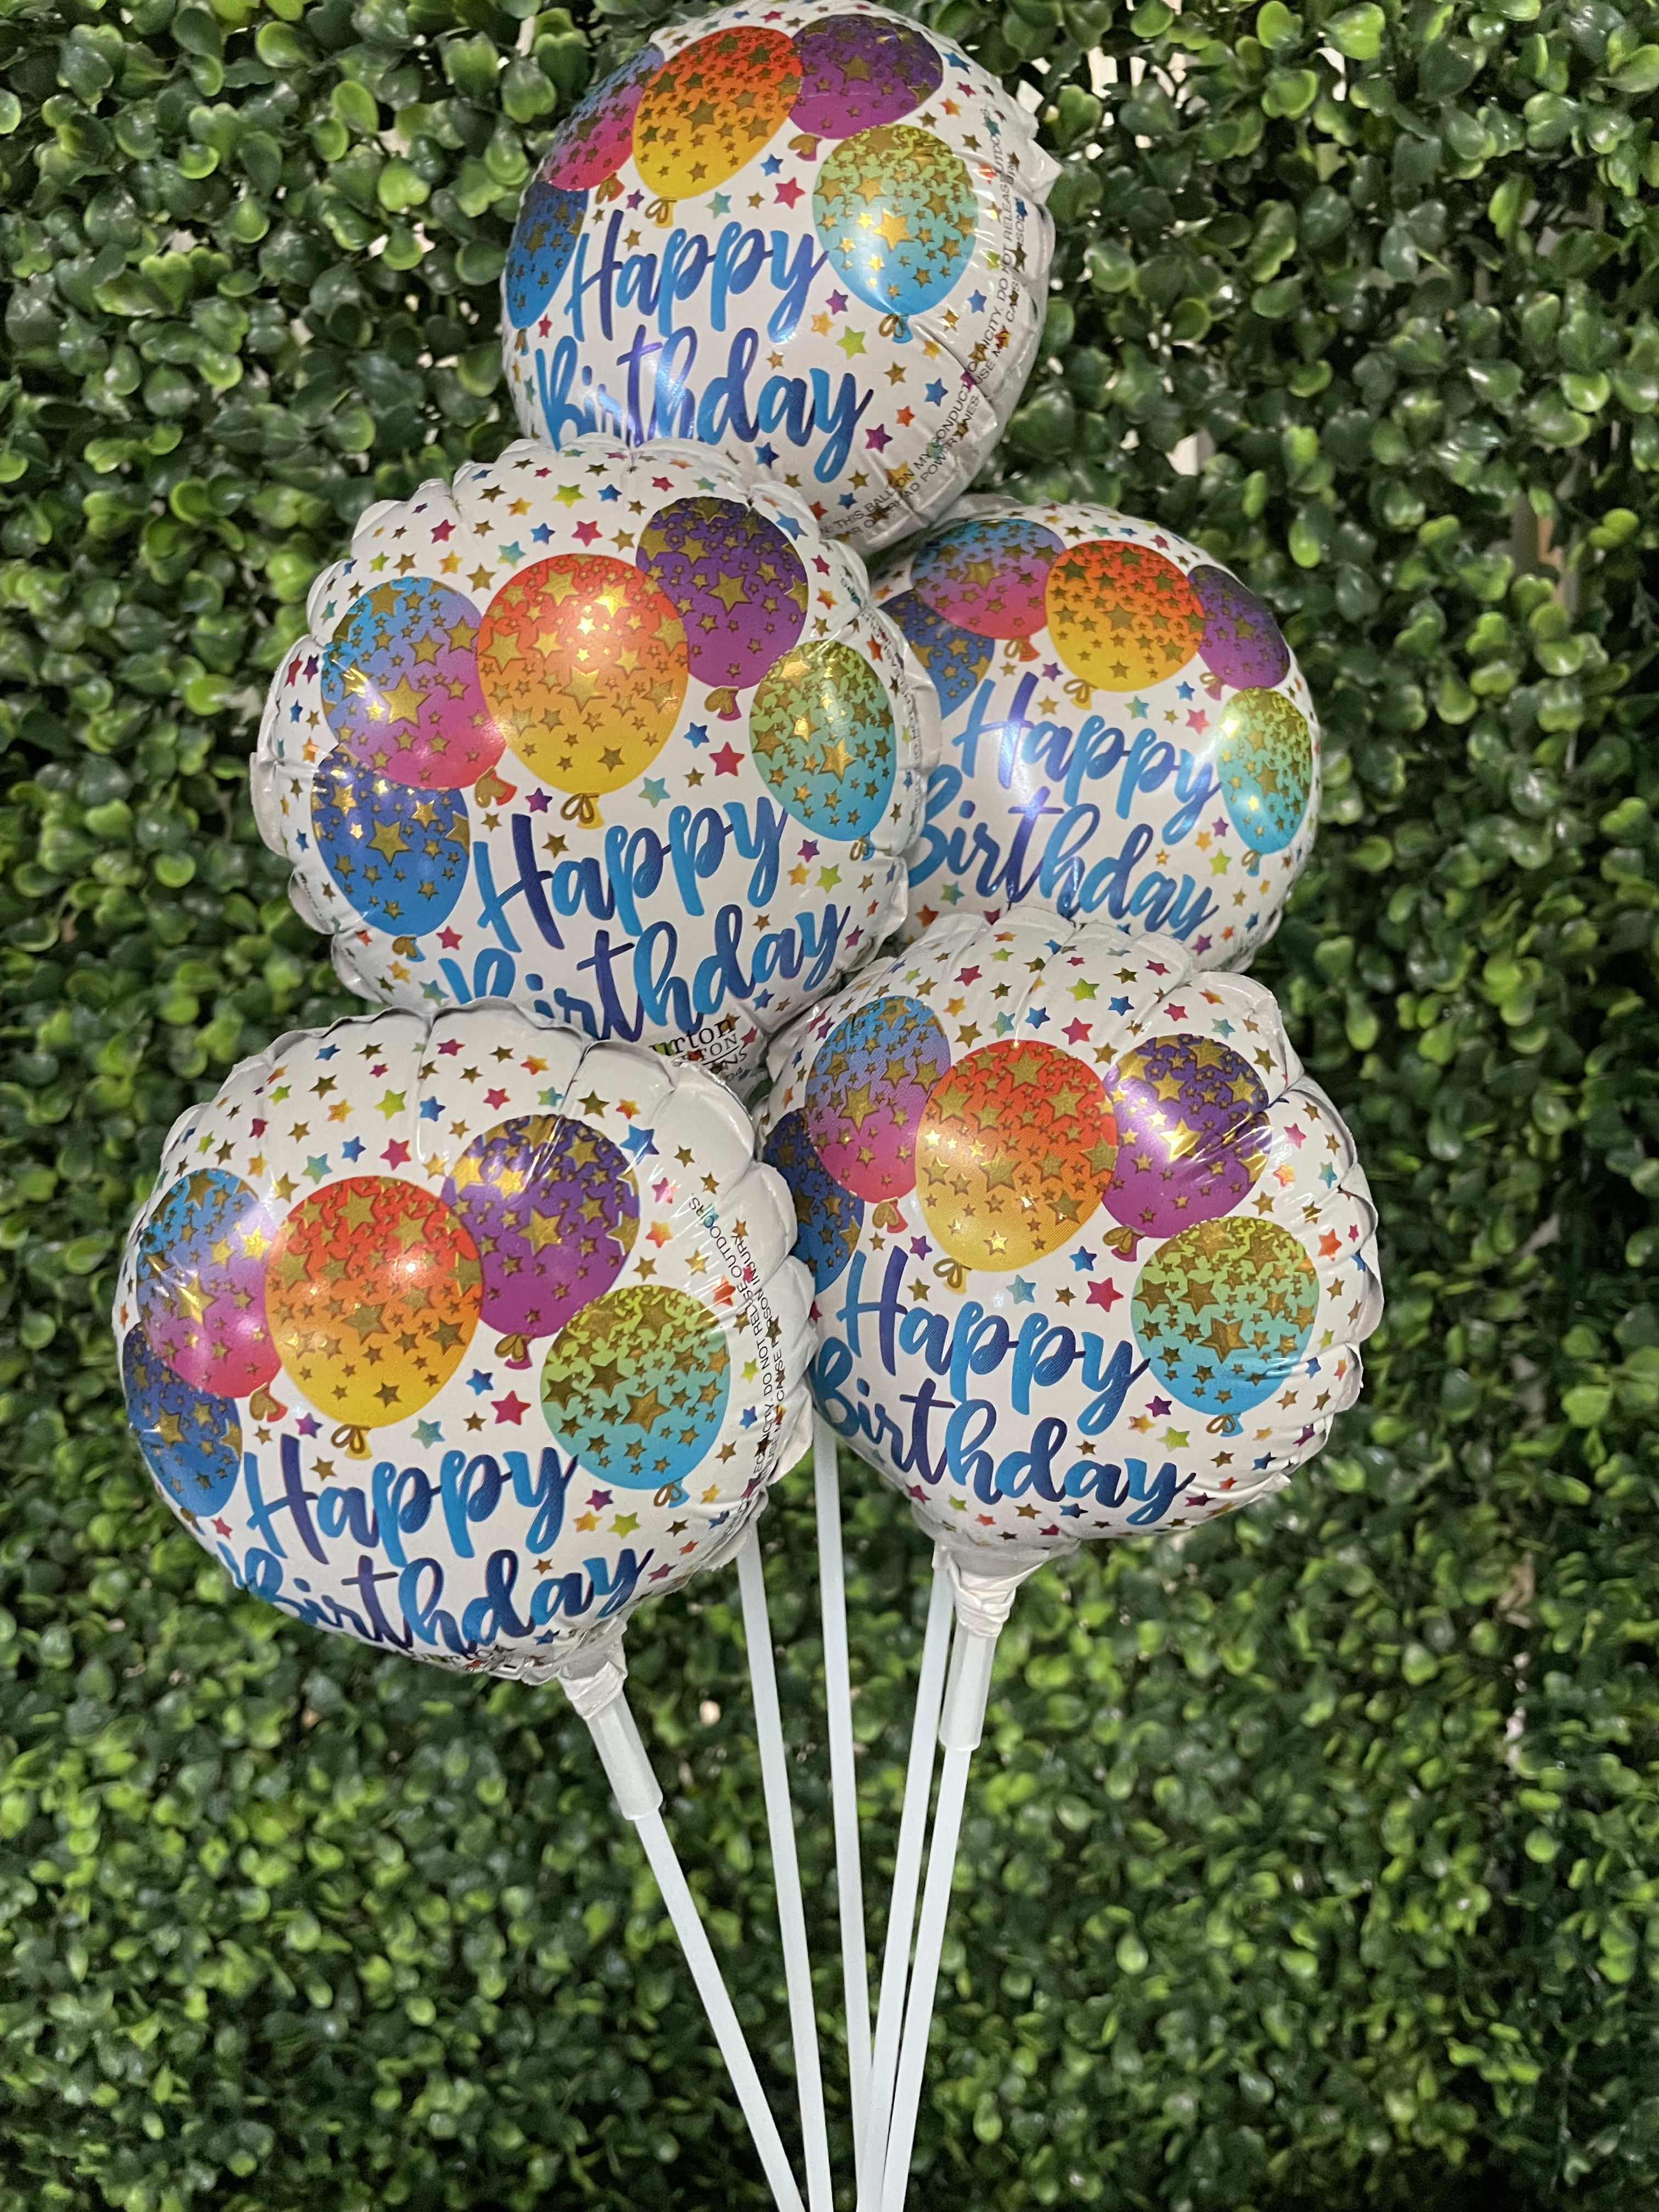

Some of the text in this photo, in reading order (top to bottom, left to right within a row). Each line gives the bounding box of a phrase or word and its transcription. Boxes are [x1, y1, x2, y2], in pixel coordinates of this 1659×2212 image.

[565, 209, 828, 343] Happy
[996, 277, 1009, 302] DO
[1001, 244, 1013, 275] NOT
[535, 325, 873, 483] Birthday
[920, 437, 958, 482] POWR
[976, 359, 997, 384] USE
[864, 469, 915, 513] BALLON
[952, 672, 1221, 845] Happy
[473, 797, 788, 953] Happy
[909, 765, 1220, 944] Birthday
[648, 1020, 737, 1057] urton
[689, 1193, 742, 1279] OUTDOORS.
[731, 1234, 760, 1285] INJURY
[756, 1289, 780, 1348] PRSON
[757, 1339, 770, 1370] NOT
[836, 1245, 1151, 1436] Happy
[763, 1372, 773, 1396] DO
[813, 1336, 1197, 1526] Birthday
[244, 1435, 579, 1568] Happy
[217, 1547, 656, 1659] Birthday
